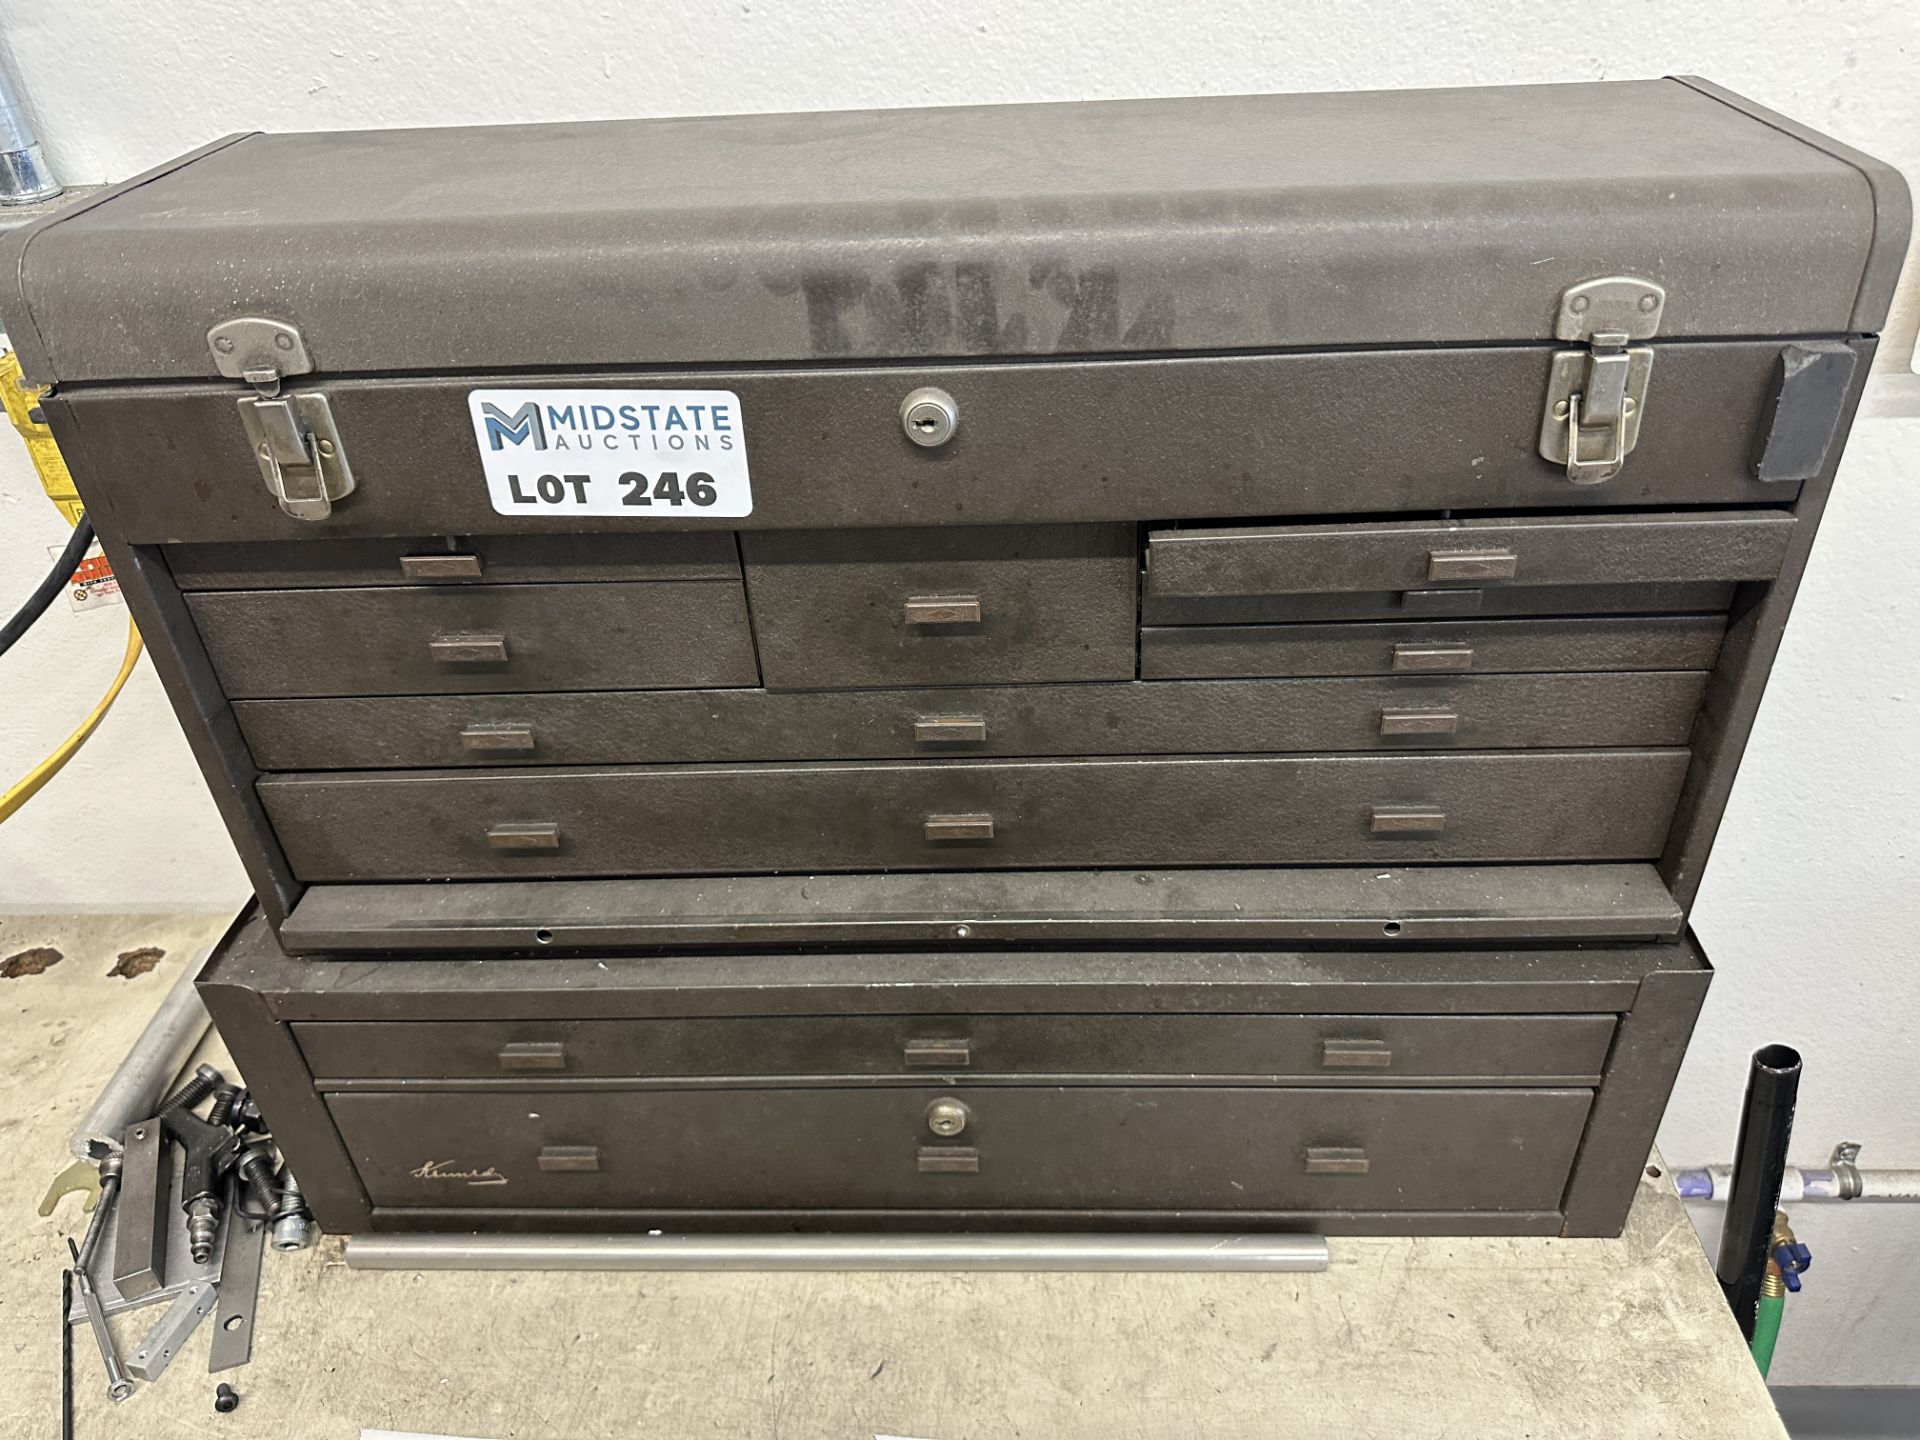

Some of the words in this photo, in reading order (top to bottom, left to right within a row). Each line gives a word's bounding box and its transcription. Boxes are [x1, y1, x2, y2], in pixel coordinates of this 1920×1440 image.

[547, 405, 732, 431] MIDSTATE
[555, 434, 733, 450] AUCTIONS
[507, 474, 592, 504] LOT
[618, 471, 718, 507] 246
